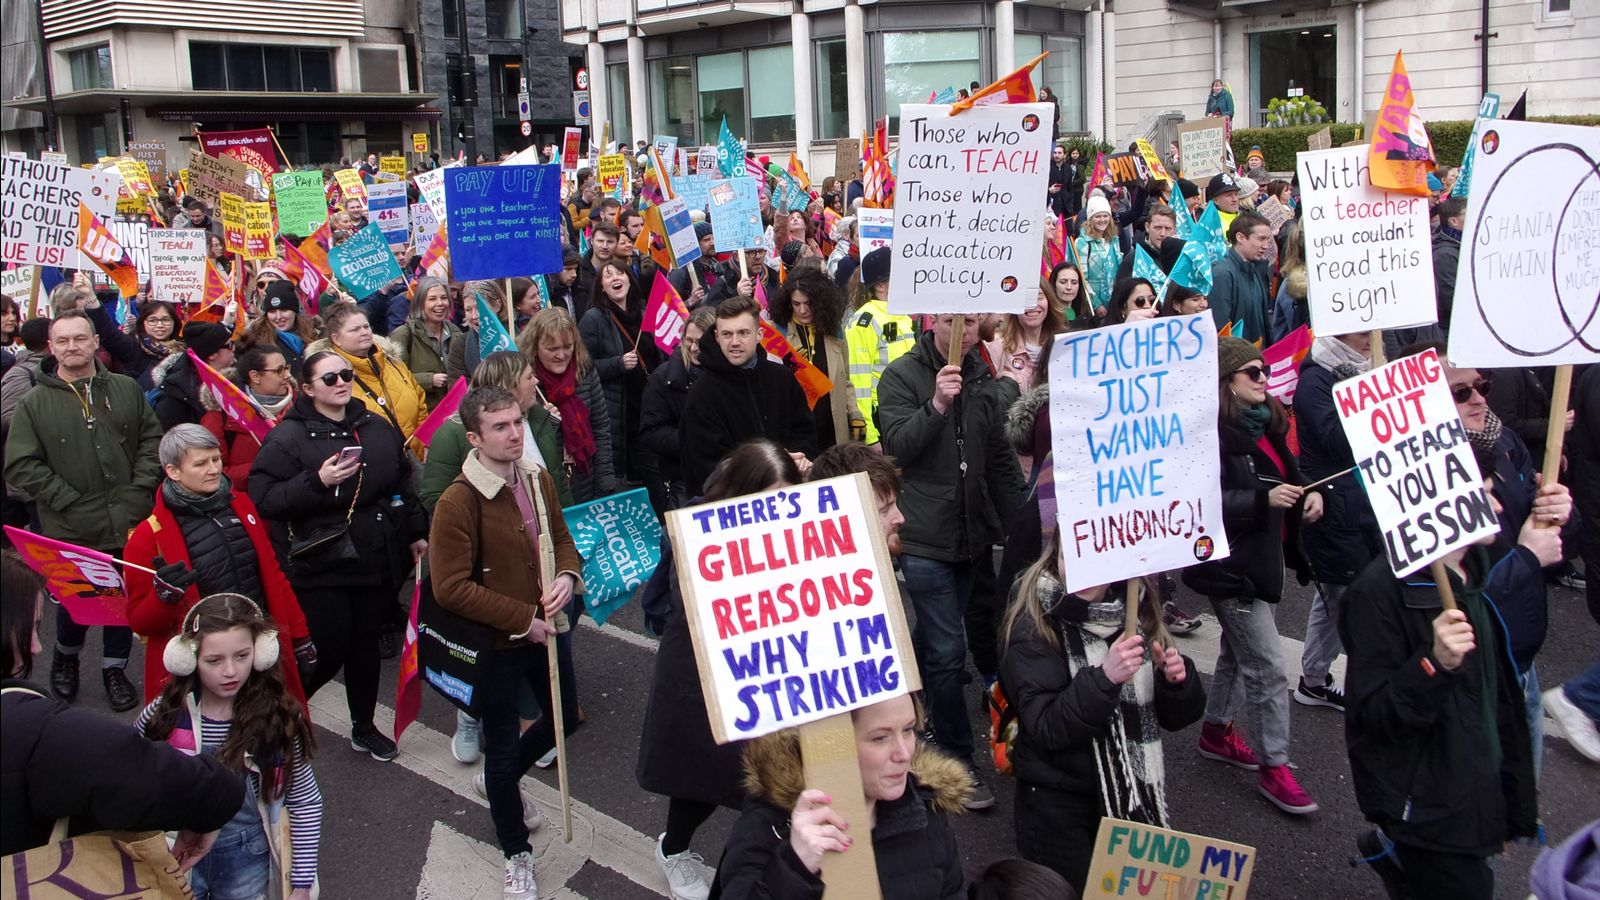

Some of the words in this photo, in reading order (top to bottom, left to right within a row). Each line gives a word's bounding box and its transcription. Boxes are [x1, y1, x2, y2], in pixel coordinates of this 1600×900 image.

[910, 118, 966, 144] Those
[978, 122, 1020, 145] who
[1024, 122, 1034, 130] UP
[129, 142, 166, 150] SCHOOLS
[0, 156, 72, 184] ITHOUT
[188, 162, 208, 174] HAVE
[192, 152, 198, 162] I
[202, 156, 234, 177] DIDN'T
[908, 154, 956, 172] can,
[960, 149, 1038, 174] TEACH.
[1108, 156, 1137, 183] PAY
[1304, 156, 1373, 190] With
[188, 172, 199, 180] OR
[188, 178, 198, 188] TO
[294, 174, 312, 188] PAY
[419, 172, 439, 184] OUR
[454, 170, 495, 197] PAY
[503, 168, 546, 199] UP!
[222, 200, 236, 212] Strike
[712, 194, 726, 206] UP
[902, 181, 962, 202] Those
[972, 183, 1012, 204] who
[2, 200, 14, 218] U
[22, 203, 111, 228] COULD'T
[128, 206, 140, 214] for
[256, 210, 268, 219] for
[378, 209, 400, 220] 41%
[461, 206, 476, 219] you
[480, 205, 496, 213] owe
[902, 210, 962, 232] can't,
[968, 210, 1030, 234] decide
[1310, 206, 1325, 220] a
[0, 220, 22, 239] AD
[113, 223, 148, 248] ING
[148, 230, 174, 238] THOSE
[248, 220, 270, 230] cation
[462, 221, 476, 232] you
[496, 218, 526, 228] support
[462, 233, 476, 243] and
[478, 234, 492, 247] you
[514, 230, 530, 239] OUR
[1314, 234, 1344, 258] you
[1352, 218, 1414, 244] couldn't
[1479, 211, 1554, 246] SHANIA
[36, 246, 65, 266] US!
[83, 228, 124, 263] UP
[158, 241, 193, 250] TEACH
[902, 237, 1012, 260] education
[1560, 229, 1600, 256] IMPRE
[1316, 248, 1371, 282] read
[1378, 247, 1420, 272] this
[1481, 250, 1547, 282] TWAIN
[1576, 254, 1592, 268] ME
[0, 268, 32, 288] OOLS
[914, 265, 990, 298] policy.
[172, 292, 192, 301] PAY
[1331, 280, 1397, 323] sign!
[654, 302, 684, 346] UP
[1064, 316, 1204, 379] TEACHERS
[1094, 370, 1170, 422] JUST
[1335, 350, 1441, 418] WALKING
[1371, 389, 1427, 444] OUT
[1086, 412, 1184, 464] WANNA
[1358, 450, 1393, 484] TO
[1394, 418, 1470, 468] TEACH
[1096, 458, 1164, 508] HAVE
[1387, 462, 1438, 514] YOU
[1444, 452, 1473, 490] A
[692, 490, 802, 534] THERE'S
[818, 484, 840, 514] A
[1384, 487, 1500, 572] LESSON
[622, 517, 658, 572] national
[697, 514, 858, 582] GILLIAN
[1196, 546, 1206, 556] UP
[595, 538, 615, 582] union
[712, 568, 874, 640] REASONS
[426, 626, 446, 646] BRIGHTON
[446, 640, 478, 658] MARATHON
[722, 630, 809, 682] WHY
[833, 613, 893, 658] I'M
[449, 648, 476, 664] WEEKEND
[734, 655, 900, 732] STRIKING
[1107, 826, 1192, 868] FUND
[1200, 845, 1249, 882] MY
